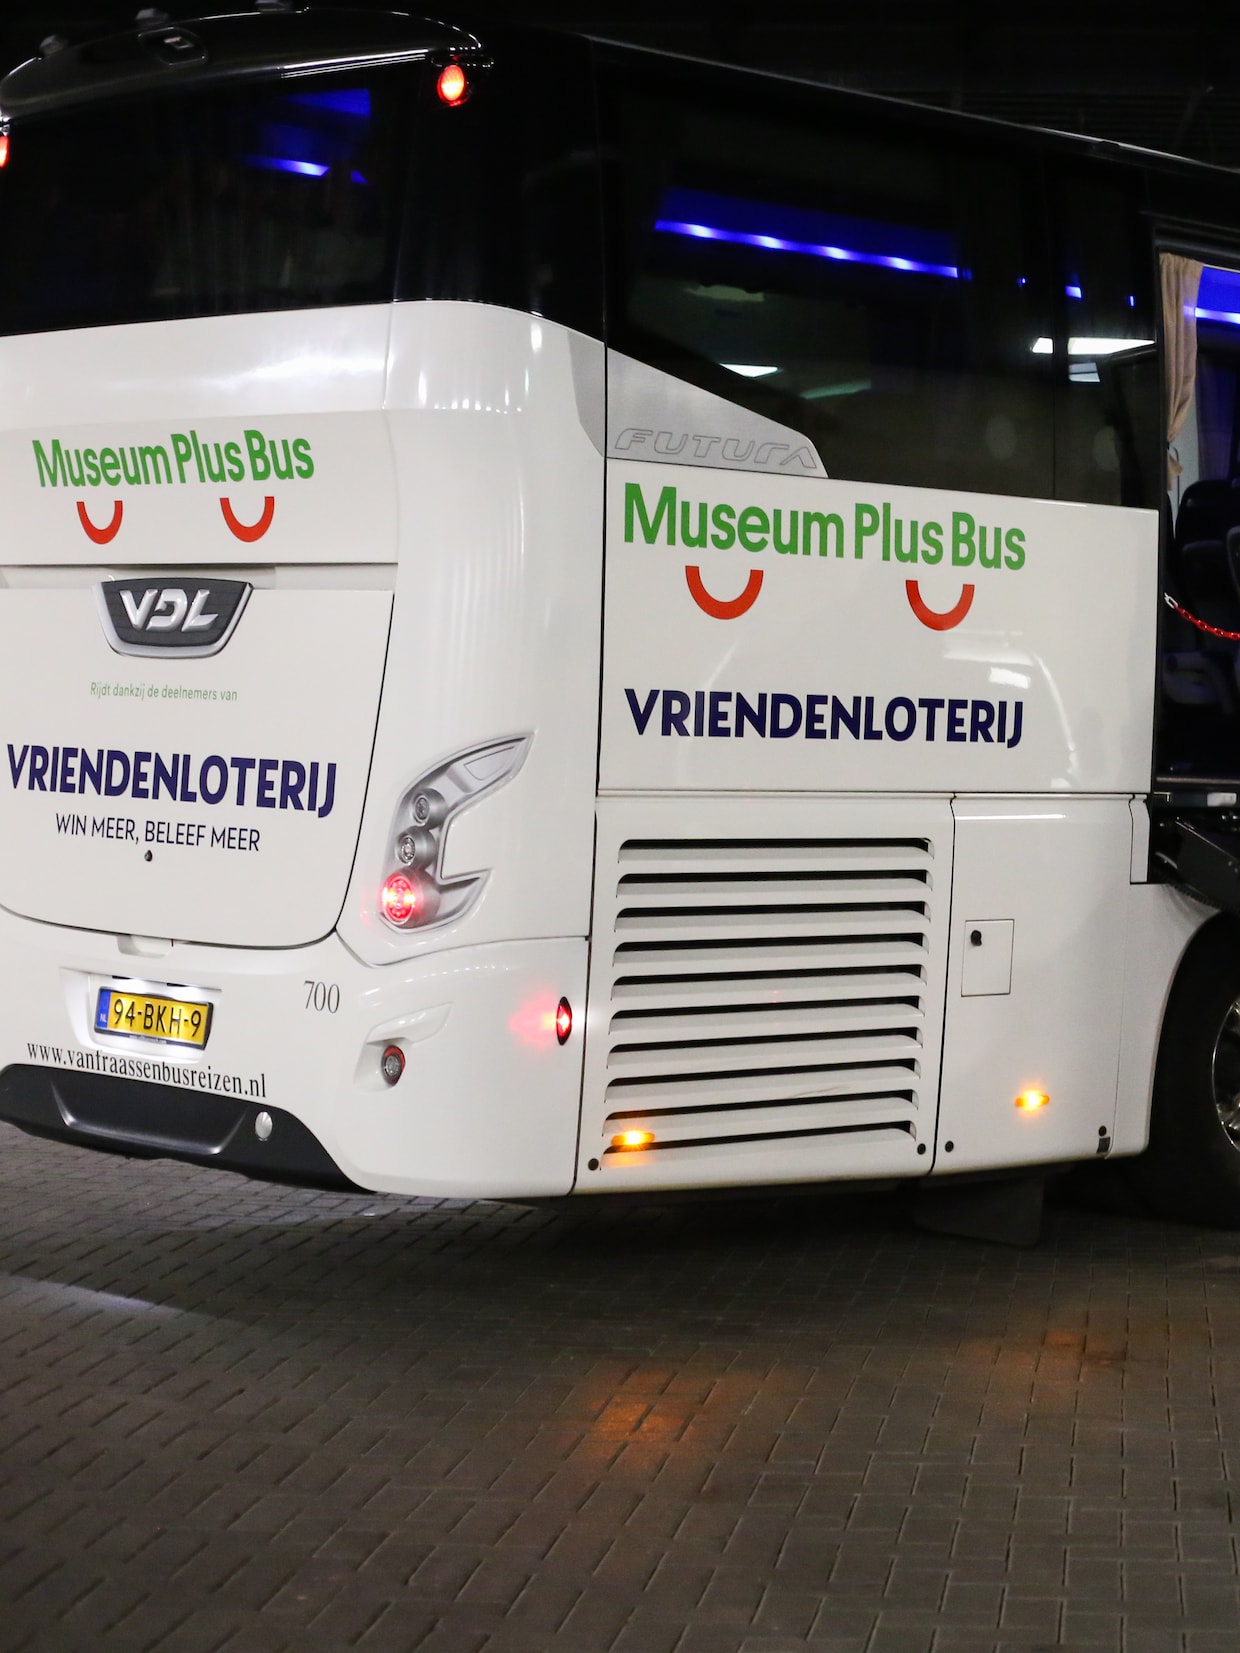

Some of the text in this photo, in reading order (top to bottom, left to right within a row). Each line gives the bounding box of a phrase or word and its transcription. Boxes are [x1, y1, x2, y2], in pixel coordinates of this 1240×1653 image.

[32, 429, 315, 487] Museum Plus Bus
[614, 428, 818, 469] FUTURA
[624, 482, 1026, 571] Museum Plus Bus
[120, 588, 219, 632] VDL
[90, 681, 238, 701] Rijdt dankzij de deelnemers van
[624, 688, 1023, 749] VRIENDENLOTERIJ
[7, 744, 337, 818] VRIENDENLOTERIJ
[56, 813, 260, 851] WIN MEER, BELEEF MEER
[99, 1013, 107, 1023] NL
[113, 998, 202, 1038] 94-BKH-9
[304, 980, 340, 1014] 700
[27, 1042, 267, 1098] www.vanfraassenbusreizen.nl
